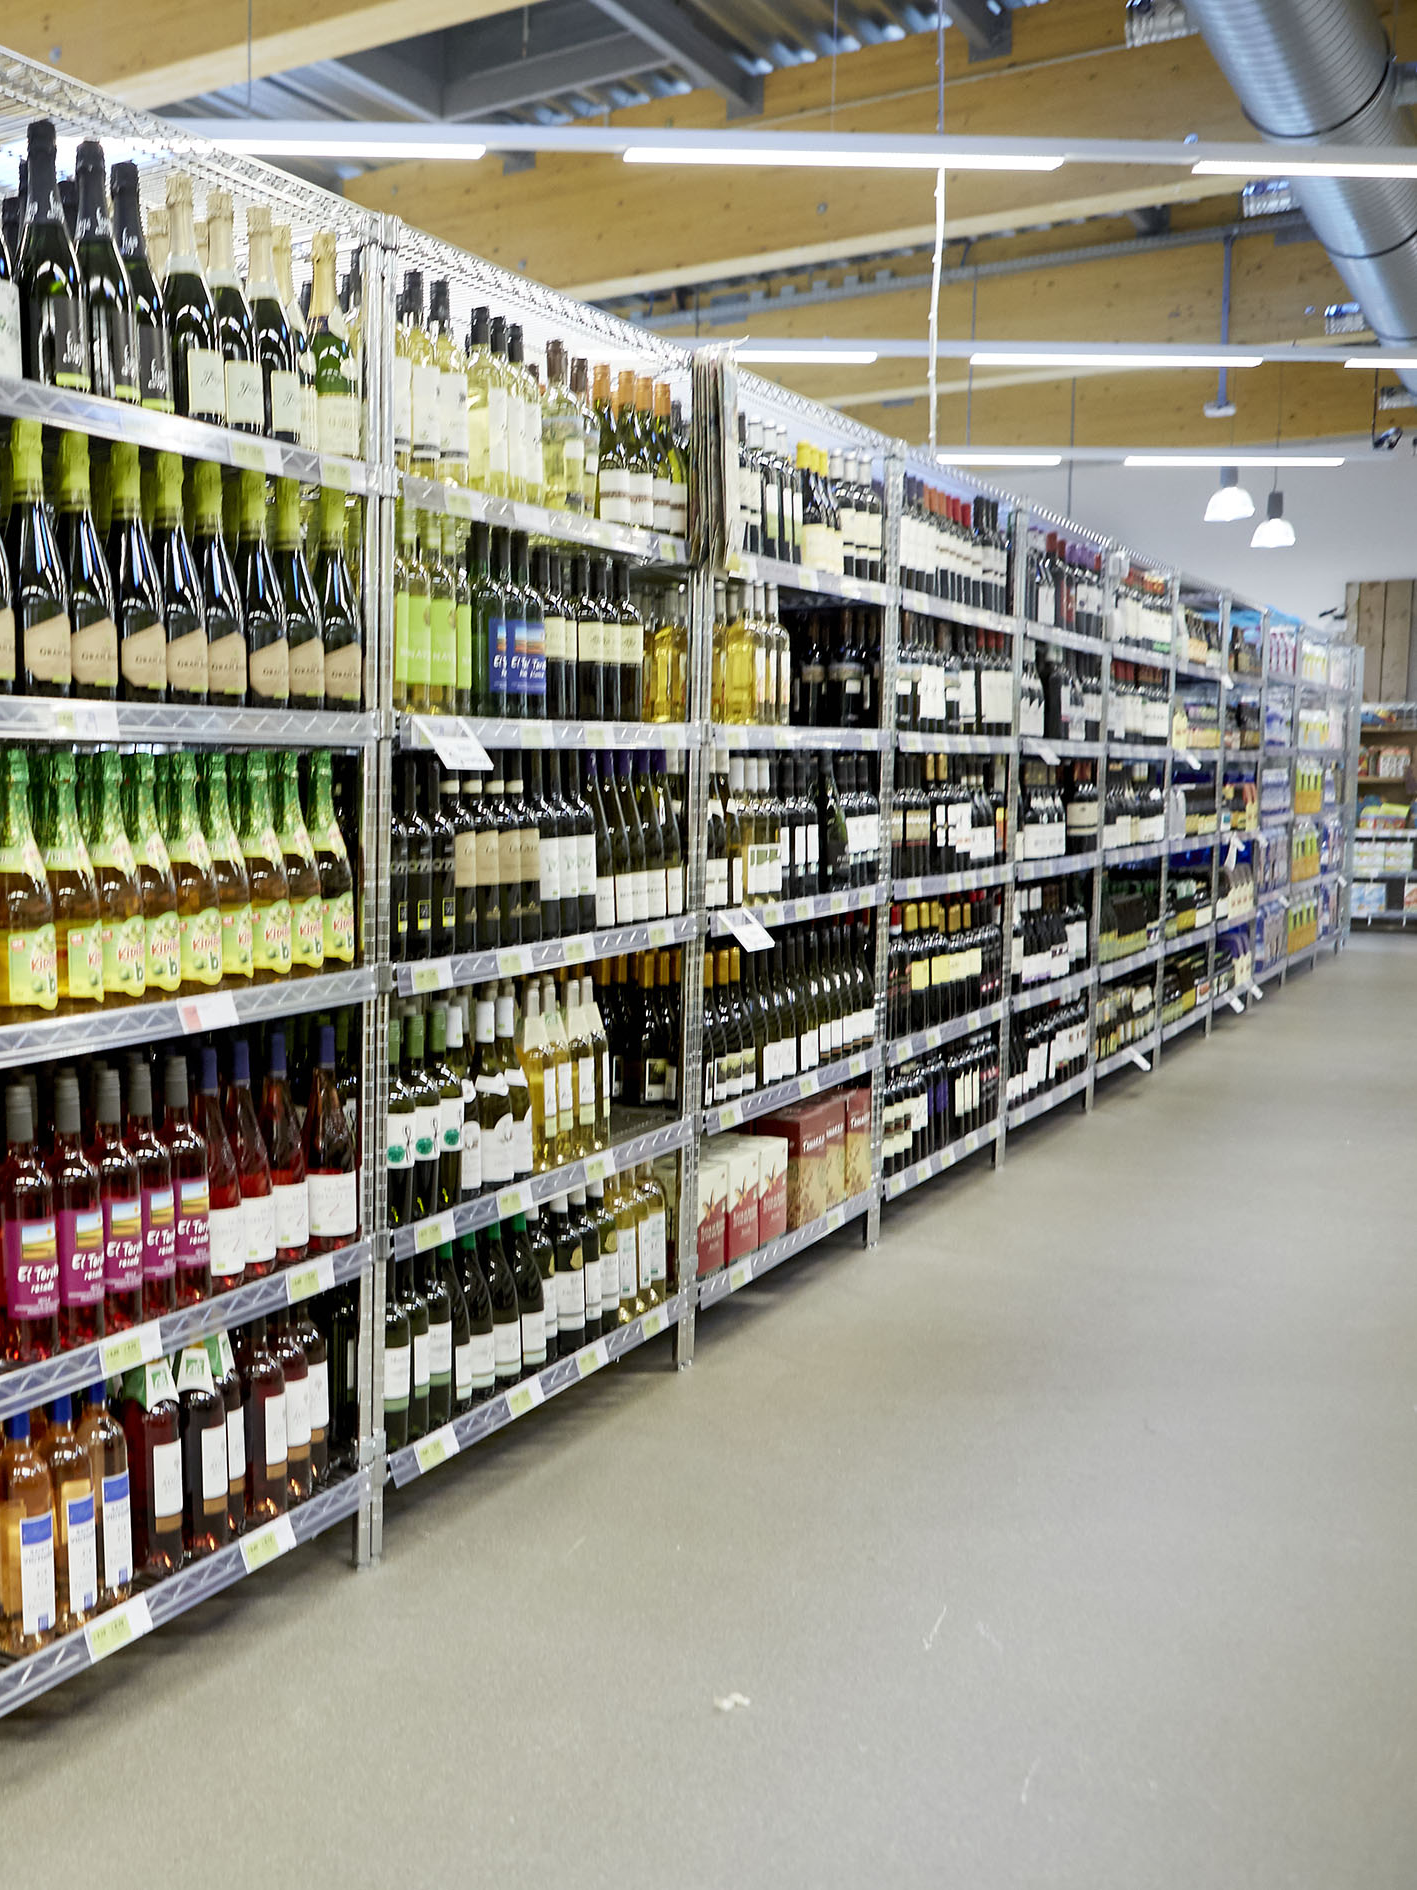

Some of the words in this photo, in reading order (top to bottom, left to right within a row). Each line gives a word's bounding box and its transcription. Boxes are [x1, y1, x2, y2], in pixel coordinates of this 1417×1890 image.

[177, 1220, 191, 1236] El
[147, 1230, 161, 1246] El
[106, 1241, 121, 1258] El
[158, 1243, 175, 1256] rosad
[72, 1253, 85, 1271] El
[18, 1266, 31, 1283] El
[84, 1267, 103, 1281] rosad
